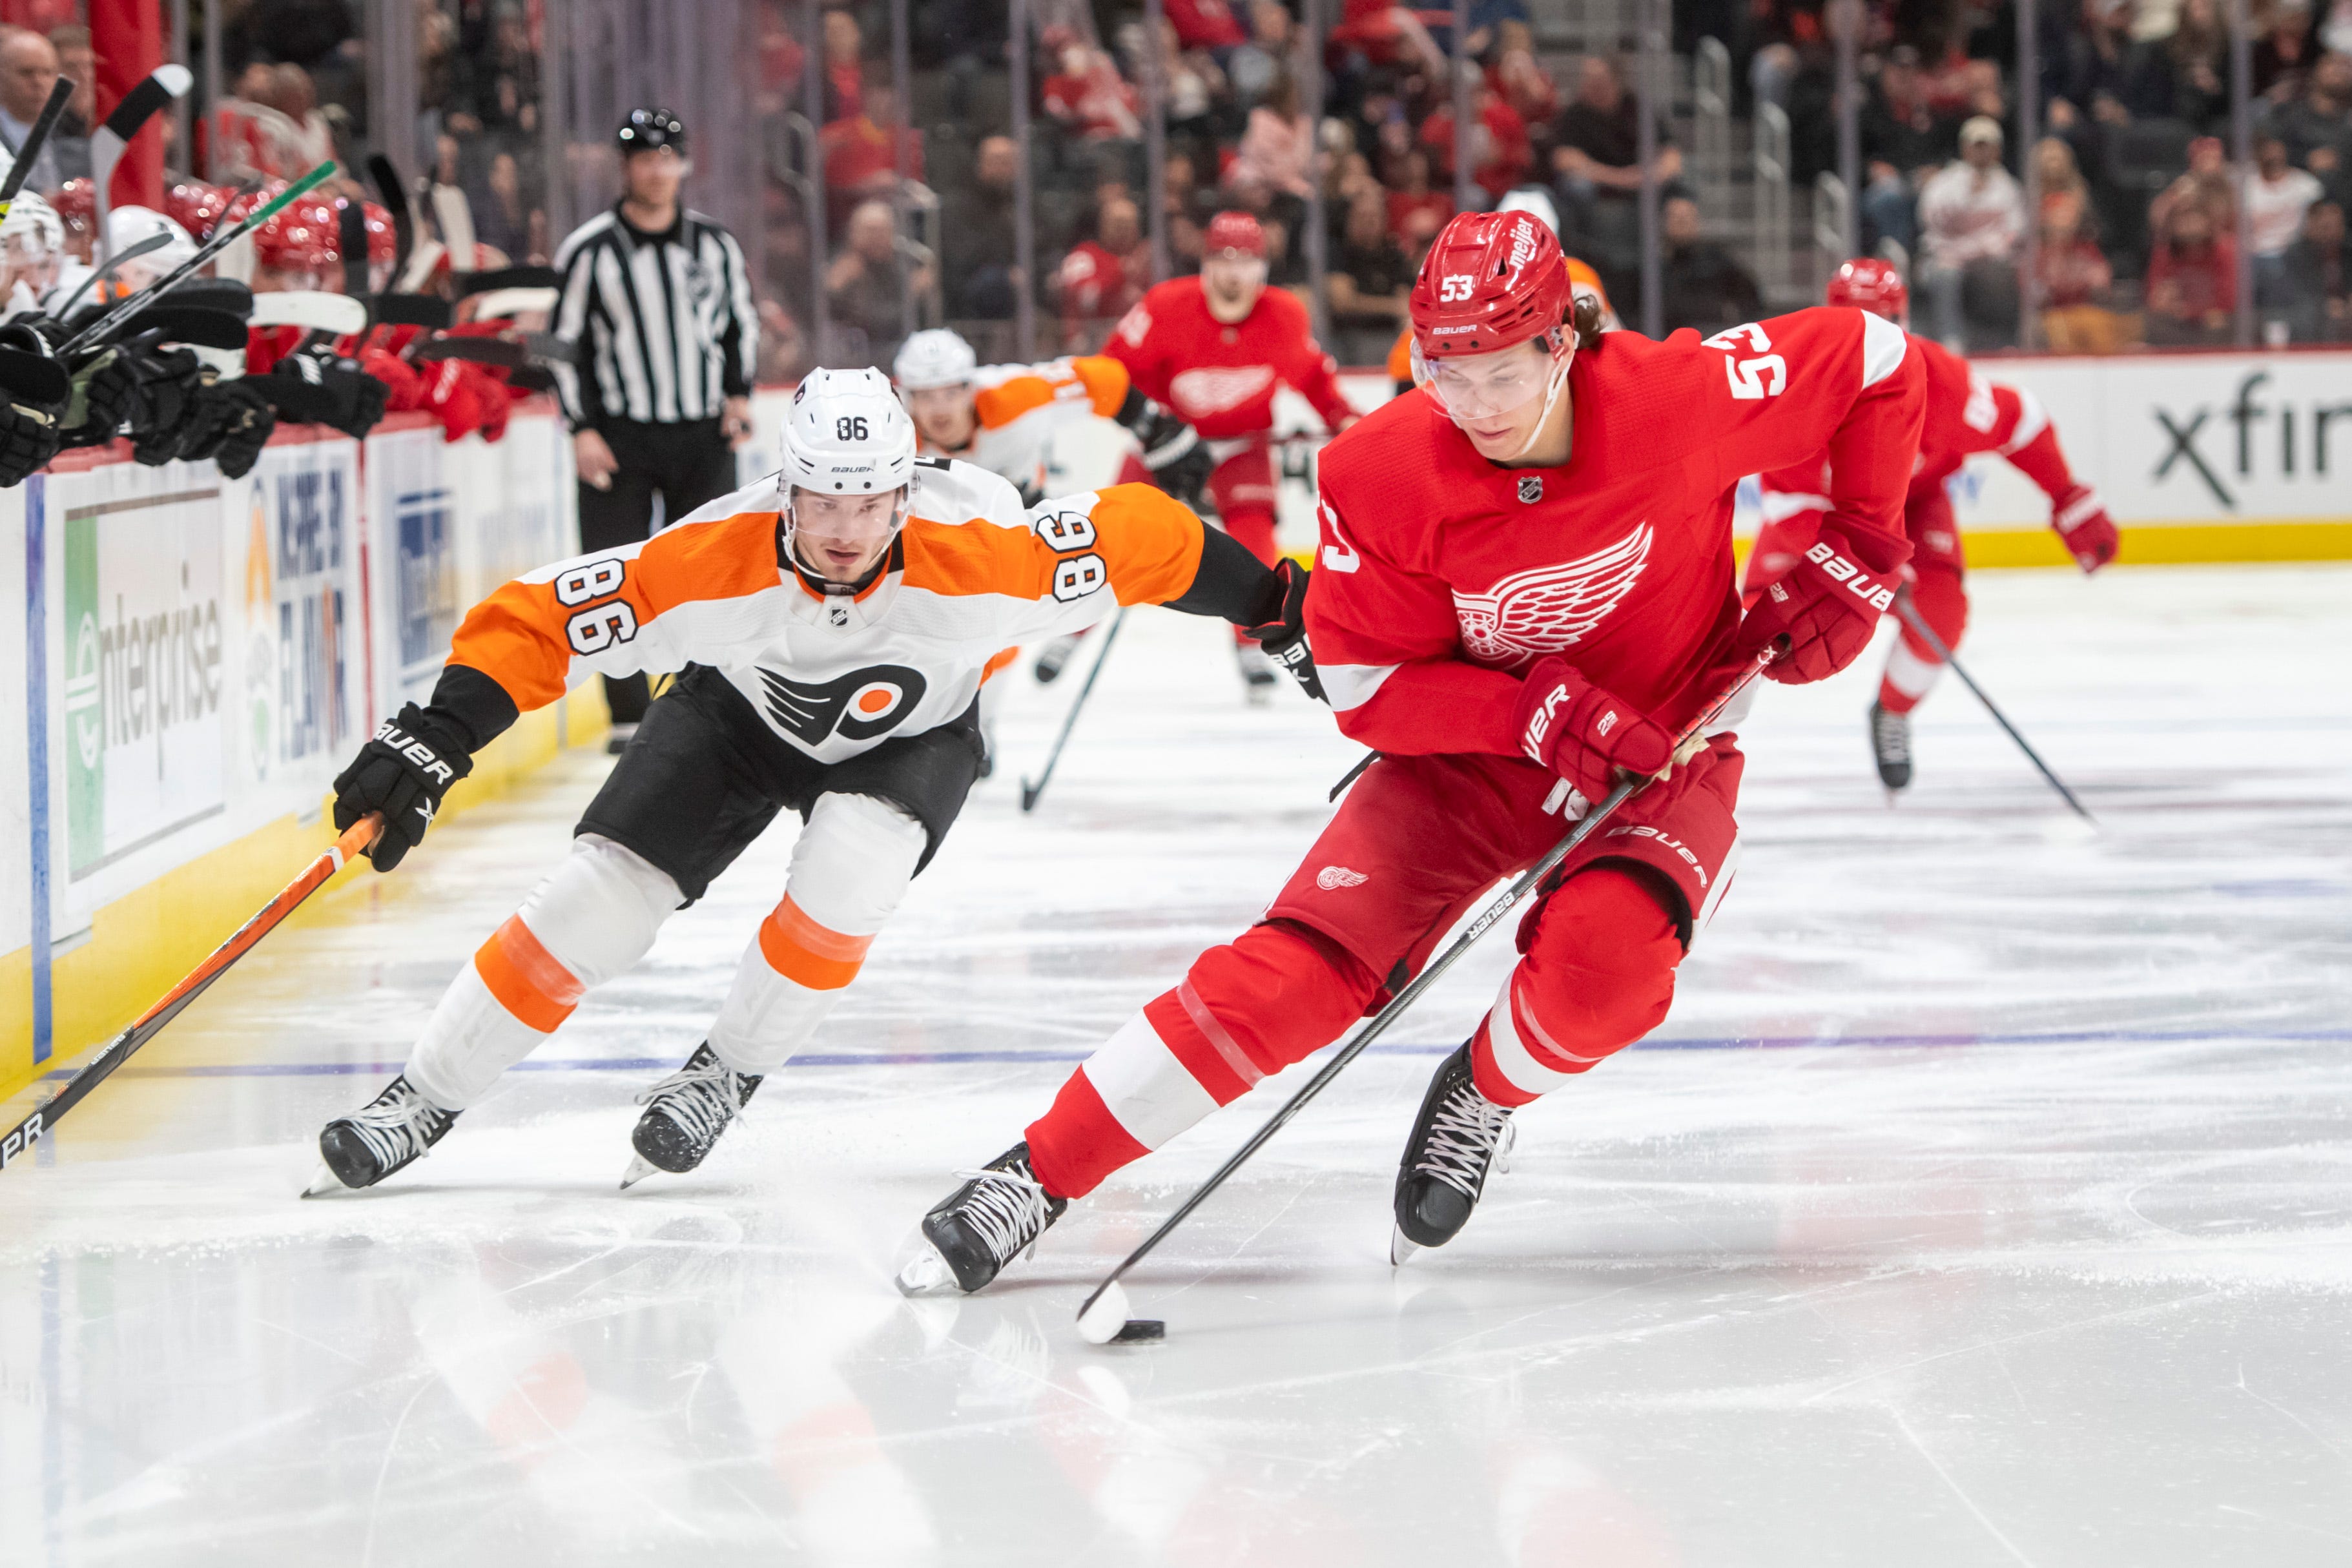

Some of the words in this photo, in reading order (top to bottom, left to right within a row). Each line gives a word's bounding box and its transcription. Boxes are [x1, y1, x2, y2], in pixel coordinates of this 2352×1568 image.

[1509, 217, 1534, 270] meijer
[1439, 274, 1474, 302] 53
[836, 417, 869, 441] 86
[1035, 511, 1107, 603] 86
[554, 558, 639, 656] 86
[65, 560, 223, 781] enterprise
